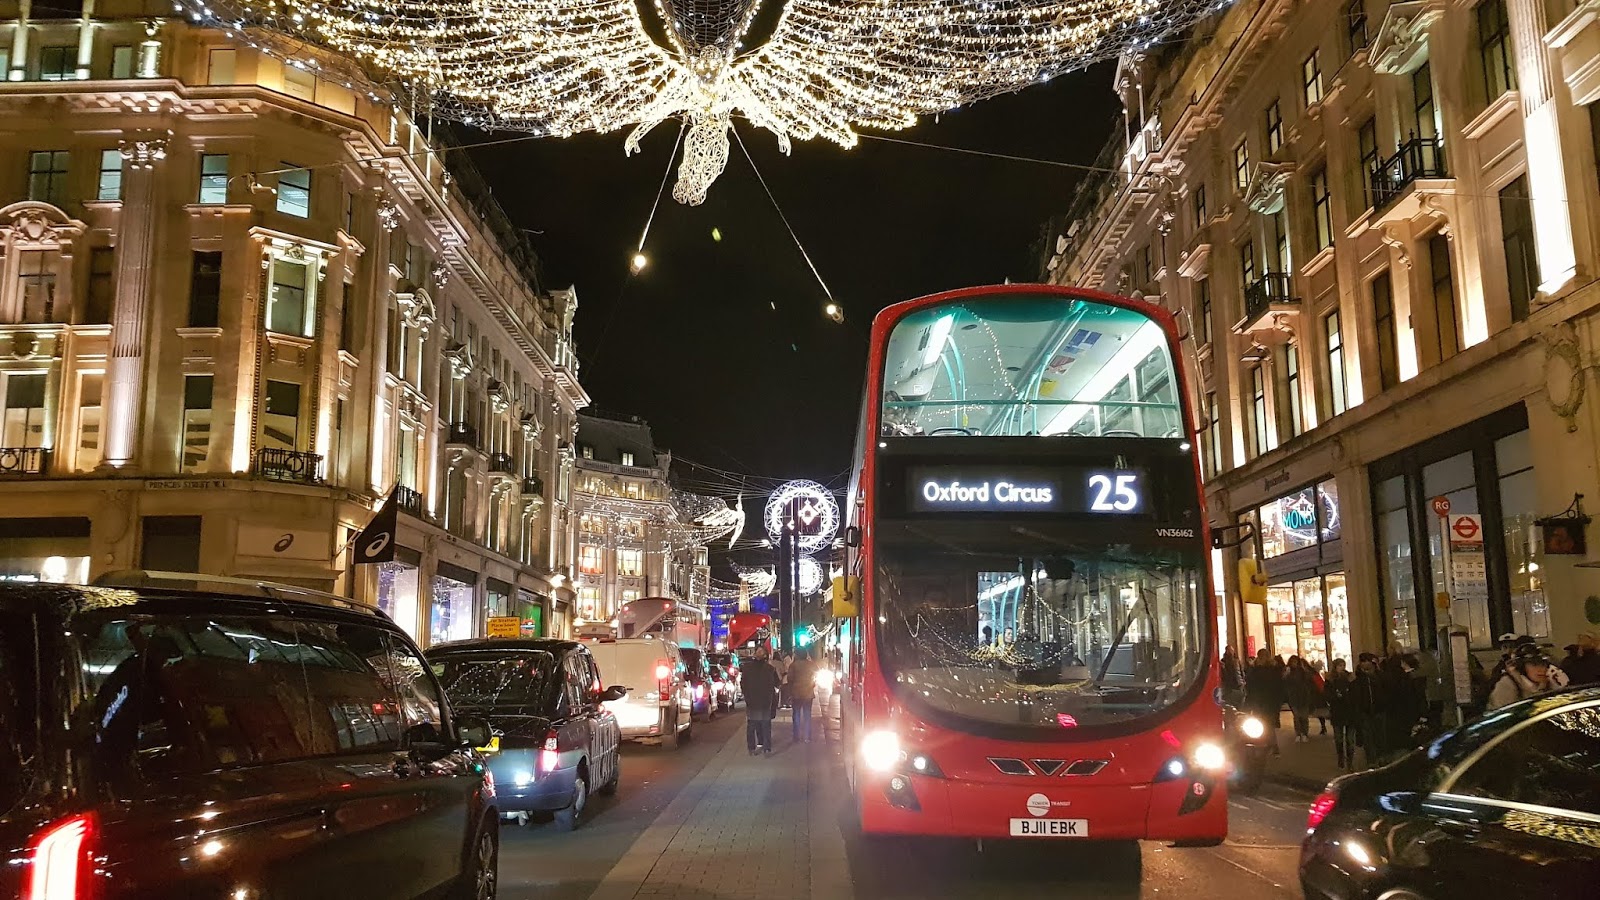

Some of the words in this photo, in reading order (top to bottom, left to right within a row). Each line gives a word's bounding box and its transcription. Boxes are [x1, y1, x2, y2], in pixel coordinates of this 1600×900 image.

[184, 481, 209, 489] STREET
[923, 481, 989, 502] Oxford
[994, 481, 1053, 503] Circus
[1088, 475, 1138, 511] 25
[1435, 502, 1449, 510] RG
[1156, 528, 1194, 538] VN36162
[1021, 821, 1046, 834] BJ11
[1050, 821, 1077, 834] EBK
